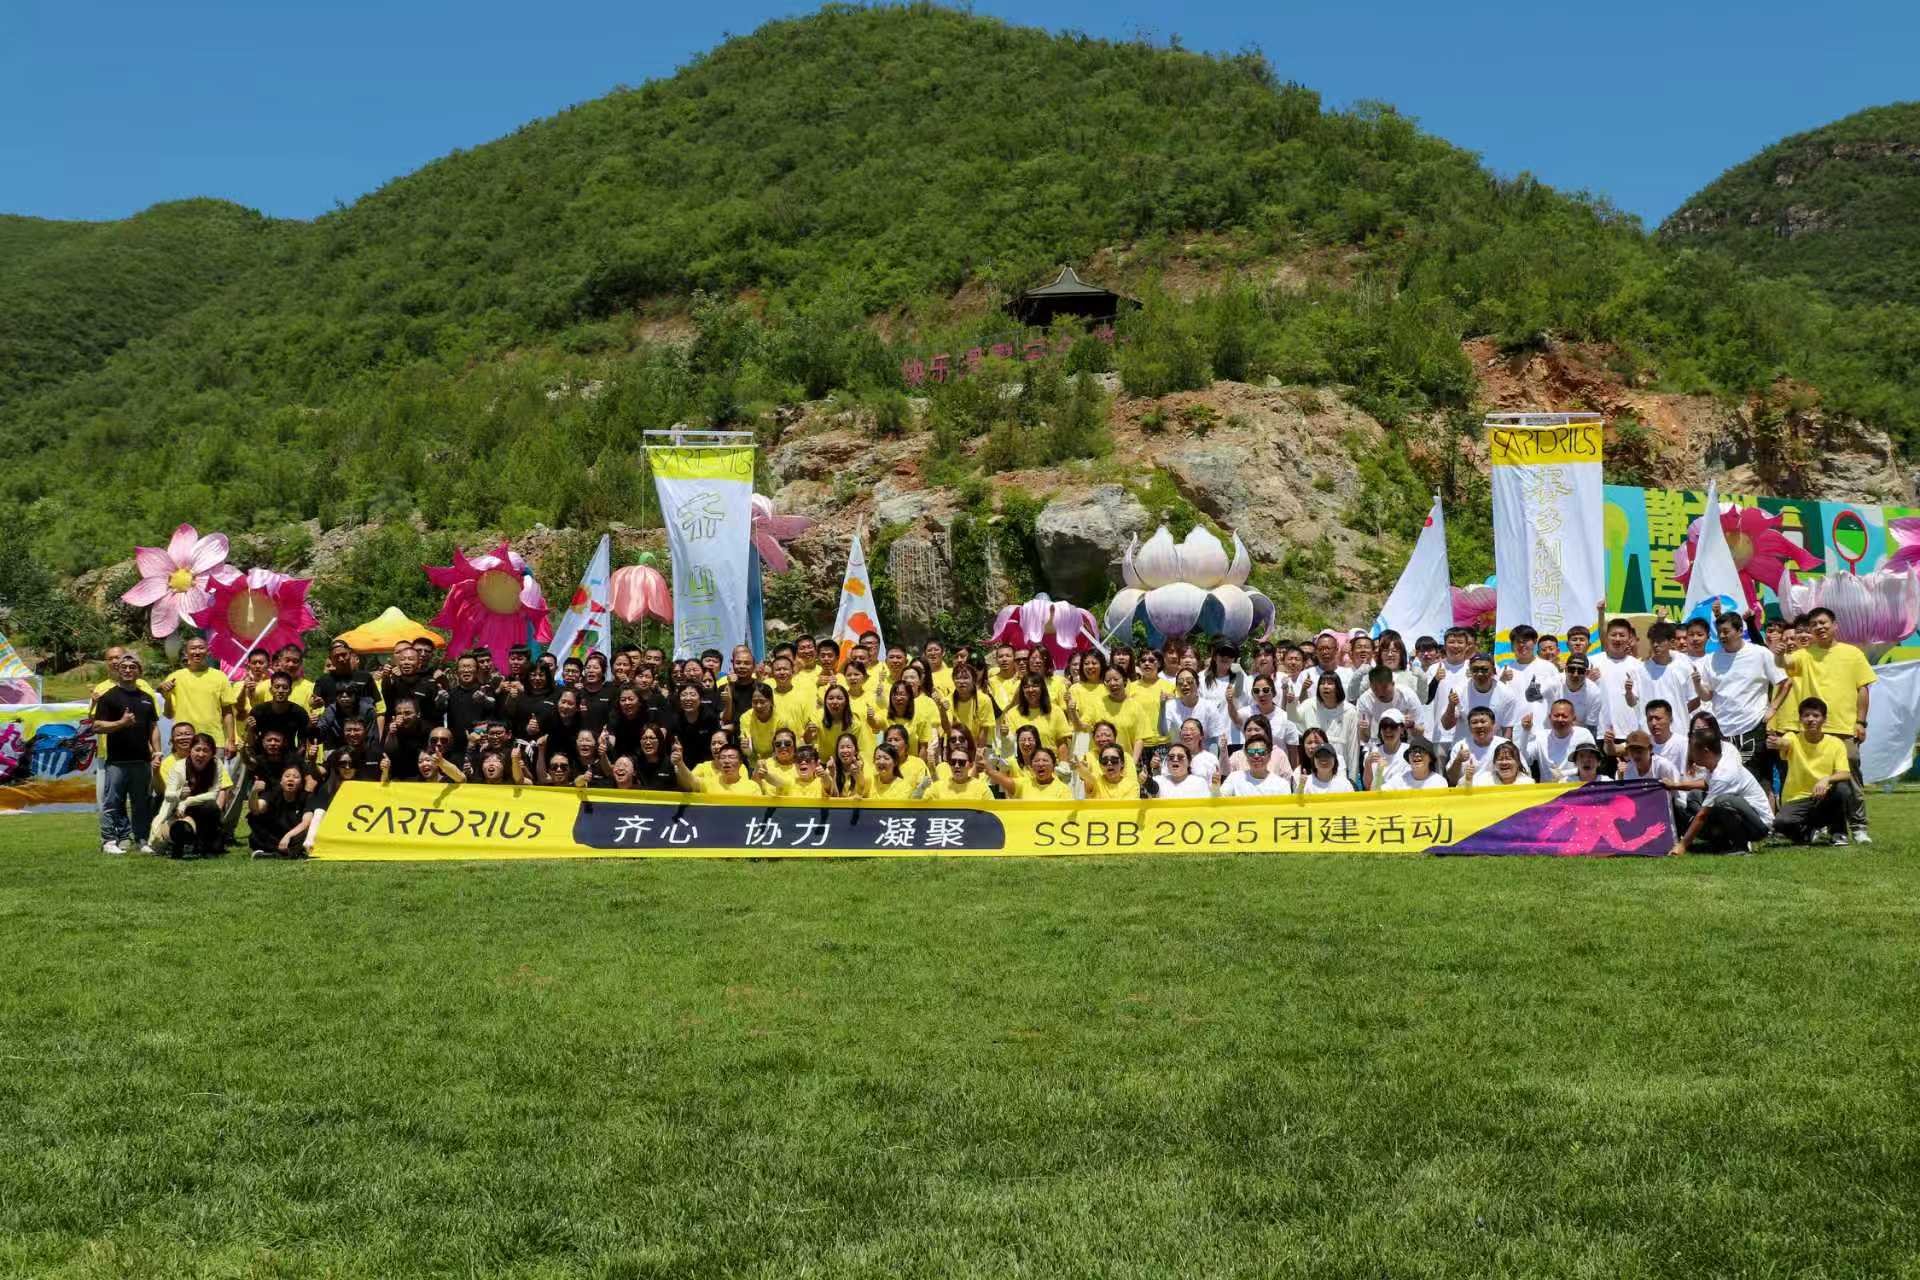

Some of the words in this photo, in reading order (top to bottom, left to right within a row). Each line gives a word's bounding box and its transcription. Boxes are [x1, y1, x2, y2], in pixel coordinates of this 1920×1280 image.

[1493, 427, 1596, 458] SARTORIUS
[347, 804, 545, 839] SARTORIUS
[613, 814, 699, 844] 齐心
[745, 816, 831, 846] 协力
[874, 817, 965, 847] 凝聚
[1034, 820, 1140, 846] SSBB
[1154, 820, 1258, 845] 2025
[1273, 813, 1453, 844] 团建活动
